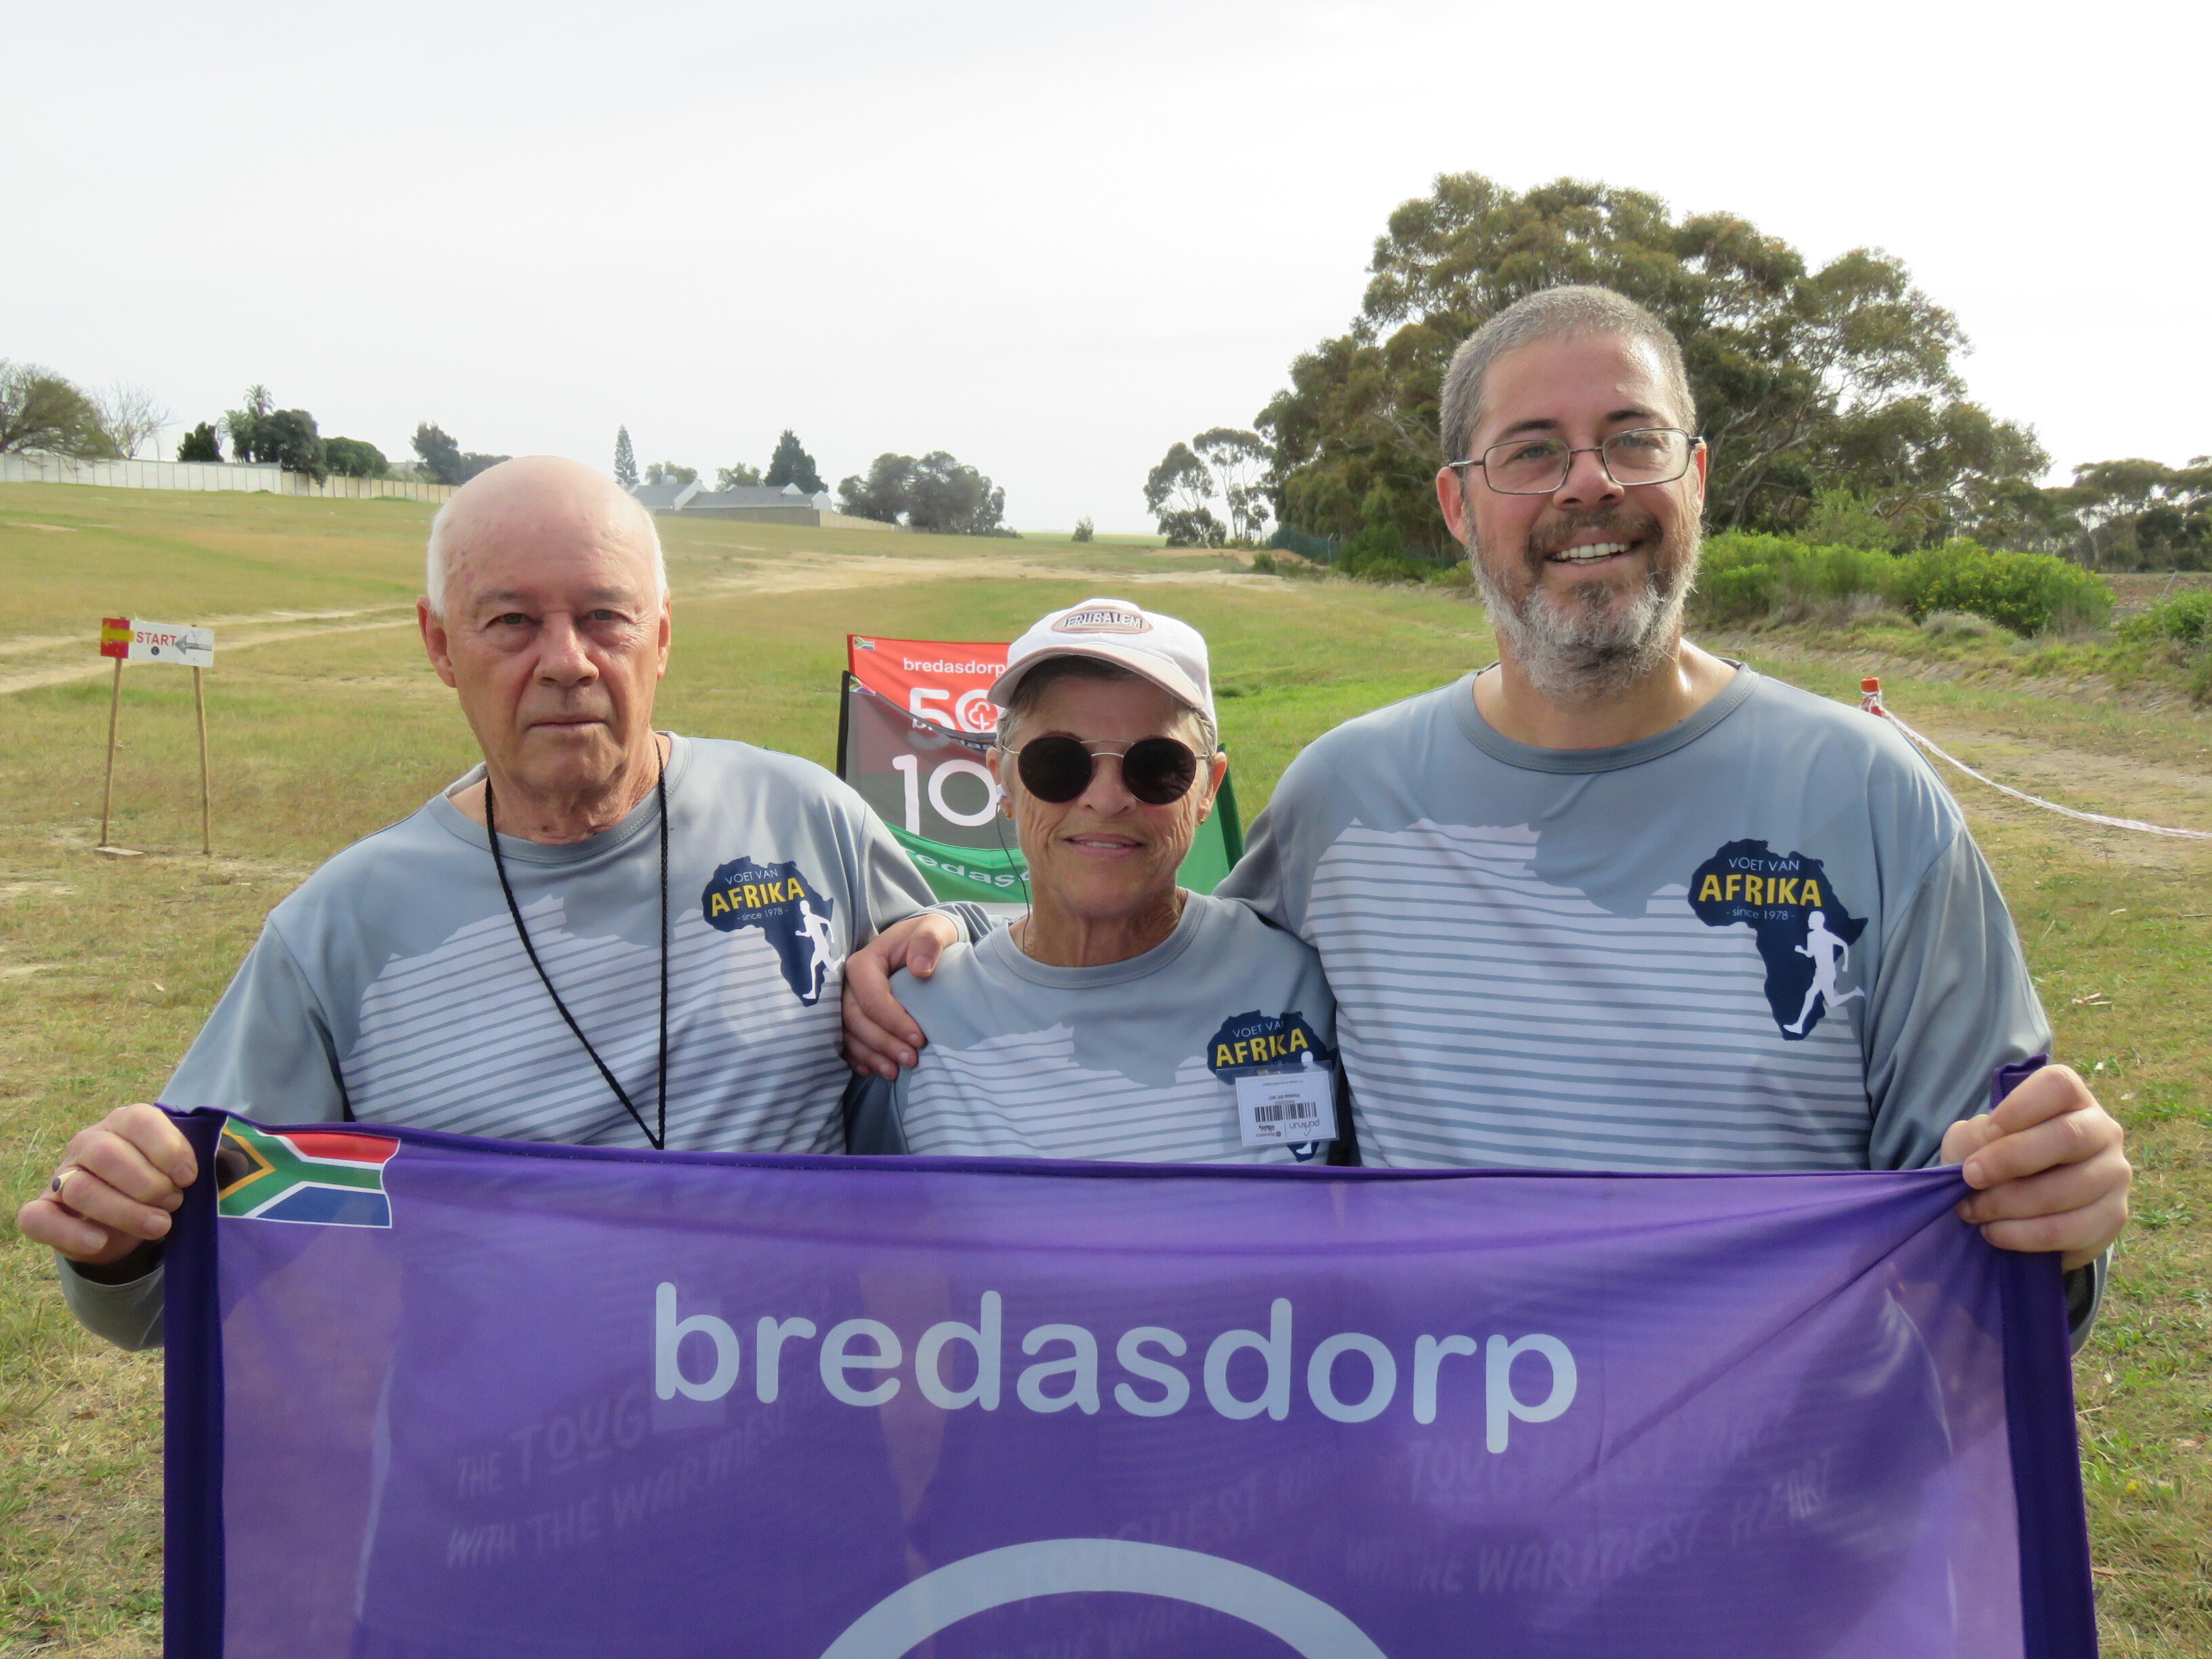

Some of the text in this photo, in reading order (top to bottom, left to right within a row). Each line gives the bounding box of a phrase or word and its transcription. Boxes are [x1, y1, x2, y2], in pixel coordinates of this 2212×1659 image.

[1057, 612, 1142, 629] JERUSALEM
[136, 632, 177, 647] START
[903, 657, 1006, 678] bredasdorp
[901, 846, 1029, 887] edas
[1729, 857, 1799, 872] VOET VAN
[724, 869, 779, 885] VOET VAN
[712, 878, 805, 917] AFRIKA
[1698, 874, 1822, 907] AFRIKA
[742, 907, 783, 921] since 1978
[1732, 906, 1788, 920] since 1978
[1232, 1025, 1262, 1038] VOET
[1216, 1028, 1309, 1067] AFRIKA
[655, 1281, 1578, 1454] bredasdorp
